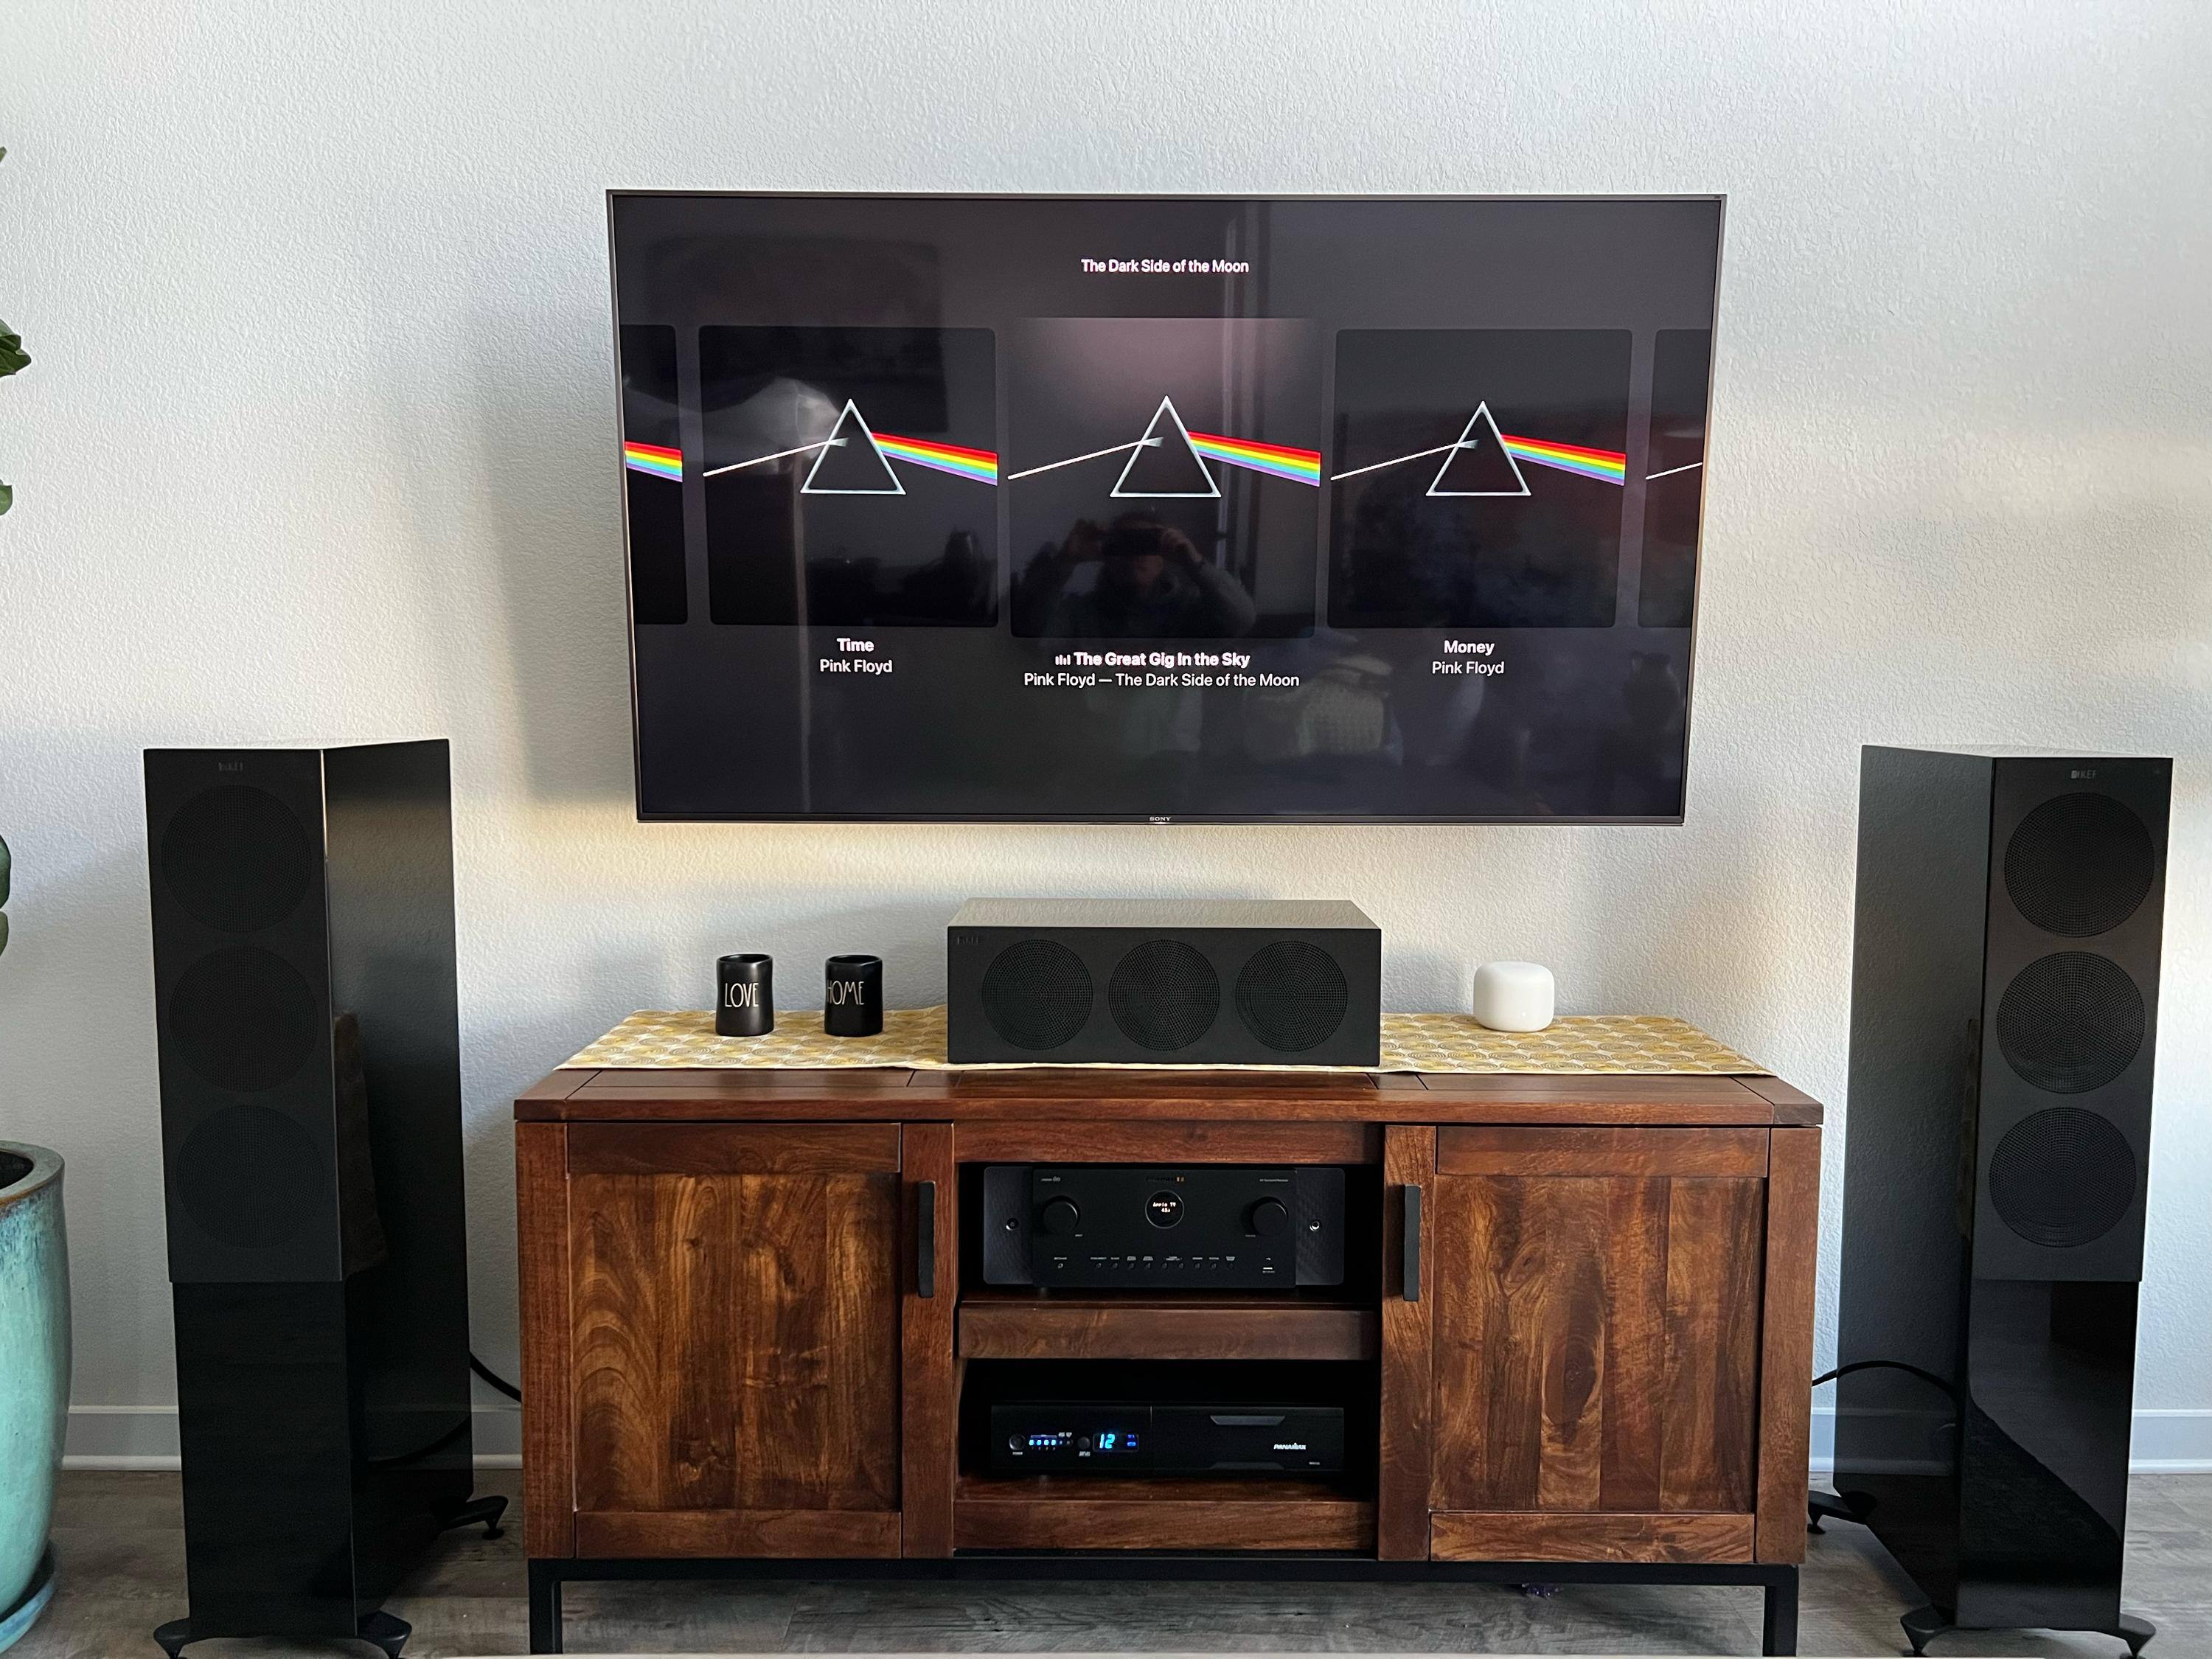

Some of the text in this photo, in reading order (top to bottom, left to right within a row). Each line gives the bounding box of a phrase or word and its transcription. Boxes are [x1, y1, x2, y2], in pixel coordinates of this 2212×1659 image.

[1081, 259, 1249, 273] The Dark Side of the Moon
[836, 638, 874, 652] Time
[1444, 640, 1495, 656] Money
[820, 659, 893, 675] Pink Floyd
[1074, 652, 1102, 666] The
[1105, 652, 1147, 666] Great
[1149, 652, 1175, 669] Gig
[1194, 653, 1219, 666] the
[1221, 653, 1251, 669] Sky
[1432, 661, 1505, 676] Pink Floyd
[1024, 672, 1054, 686] Pink
[1057, 672, 1096, 689] Floyd
[1115, 673, 1142, 686] The
[1146, 673, 1178, 686] Dark
[1181, 673, 1213, 686] Side
[1216, 673, 1231, 686] of
[1233, 673, 1256, 686] the
[1259, 673, 1300, 686] Moon
[725, 982, 759, 1008] LOVE
[1099, 1433, 1115, 1449] 12
